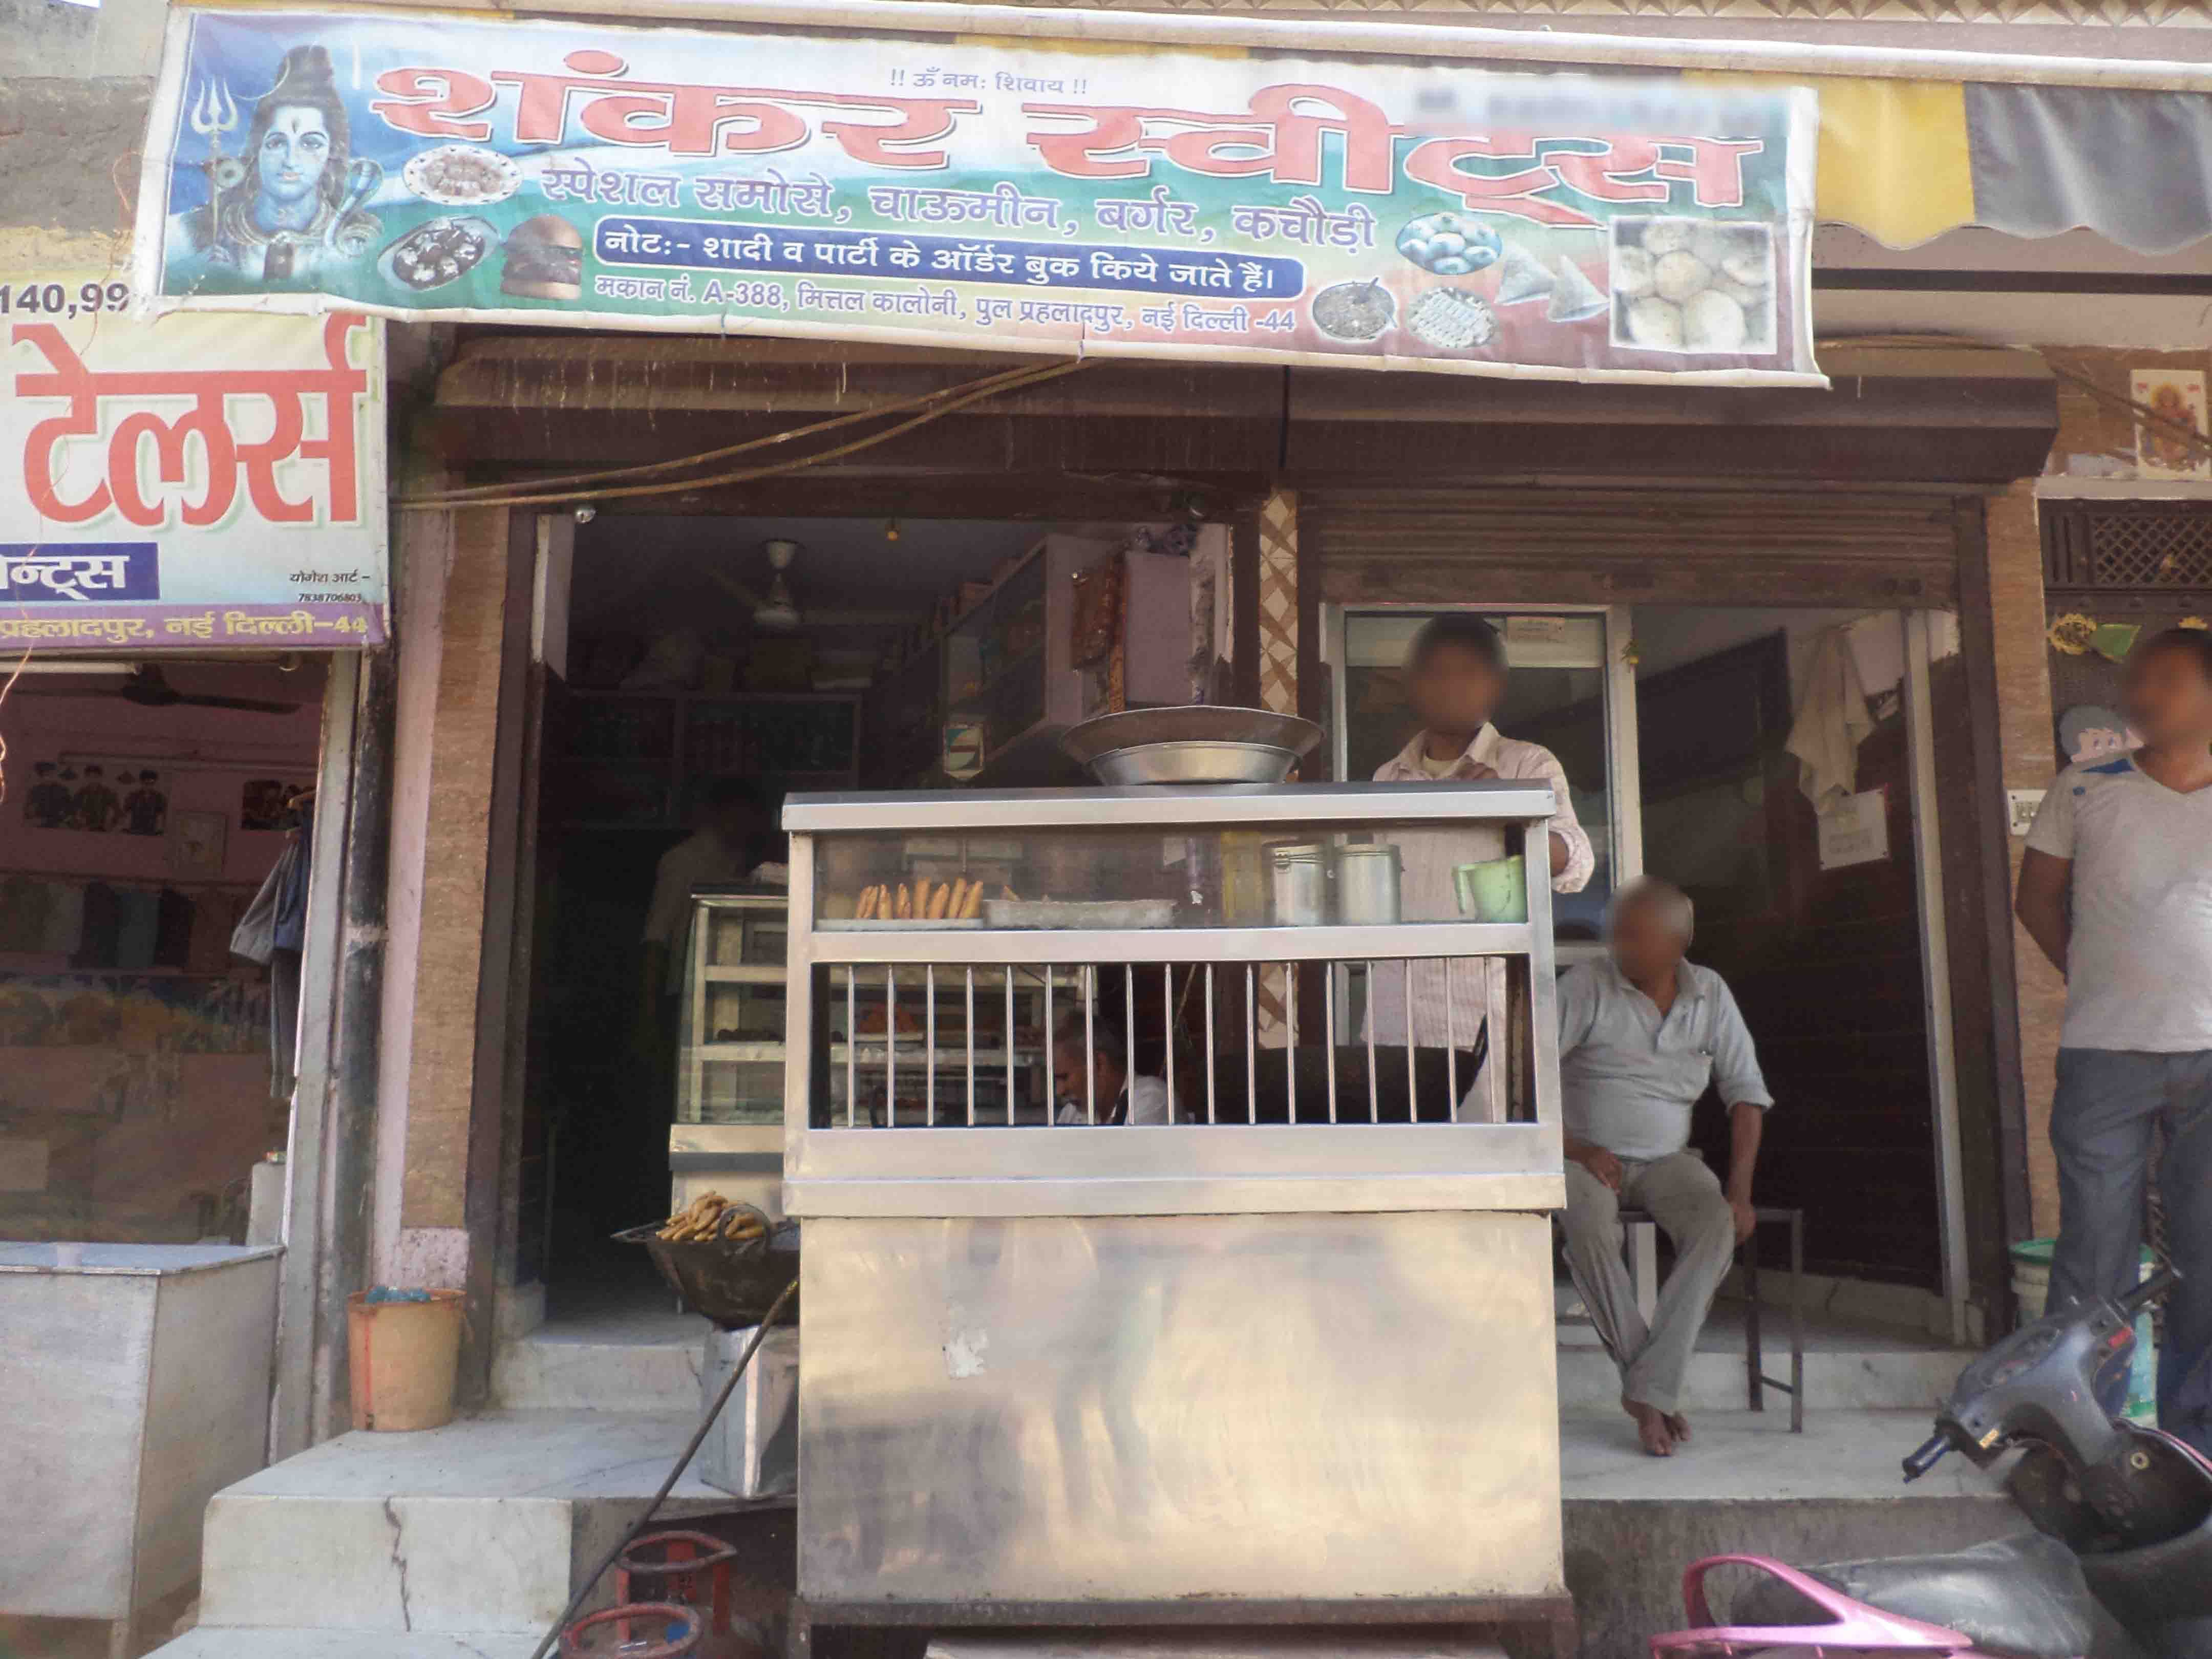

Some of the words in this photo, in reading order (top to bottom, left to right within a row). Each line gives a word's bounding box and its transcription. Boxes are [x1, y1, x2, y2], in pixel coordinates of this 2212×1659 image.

[995, 71, 1064, 93] शिवाय
[541, 157, 680, 206] स्पेशल
[695, 169, 852, 223] समोसे,
[869, 182, 1079, 236] चाऊमीन,
[1095, 186, 1215, 242] बर्गर,
[1232, 195, 1375, 253] कचौड़ी
[703, 233, 772, 262] शादी
[783, 242, 803, 261] व
[815, 237, 878, 267] पार्टी
[889, 240, 920, 268] के
[932, 243, 1014, 274] ऑर्डर
[1025, 254, 1080, 284] बुक
[1090, 251, 1157, 282] किये
[1168, 258, 1232, 288] जाते
[595, 275, 665, 301] मकान
[701, 280, 790, 311] A-388,
[797, 281, 865, 312] मित्तल
[872, 285, 966, 320] कालोनी,
[975, 295, 1012, 326] पुल
[1019, 300, 1133, 332] प्रहलादपुर,
[1141, 301, 1175, 333] नई
[1183, 305, 1247, 331] दिल्ली
[1255, 311, 1295, 330] -44
[12, 312, 367, 523] टेलर्स
[332, 569, 358, 583] आर्ट
[164, 612, 215, 639] नई
